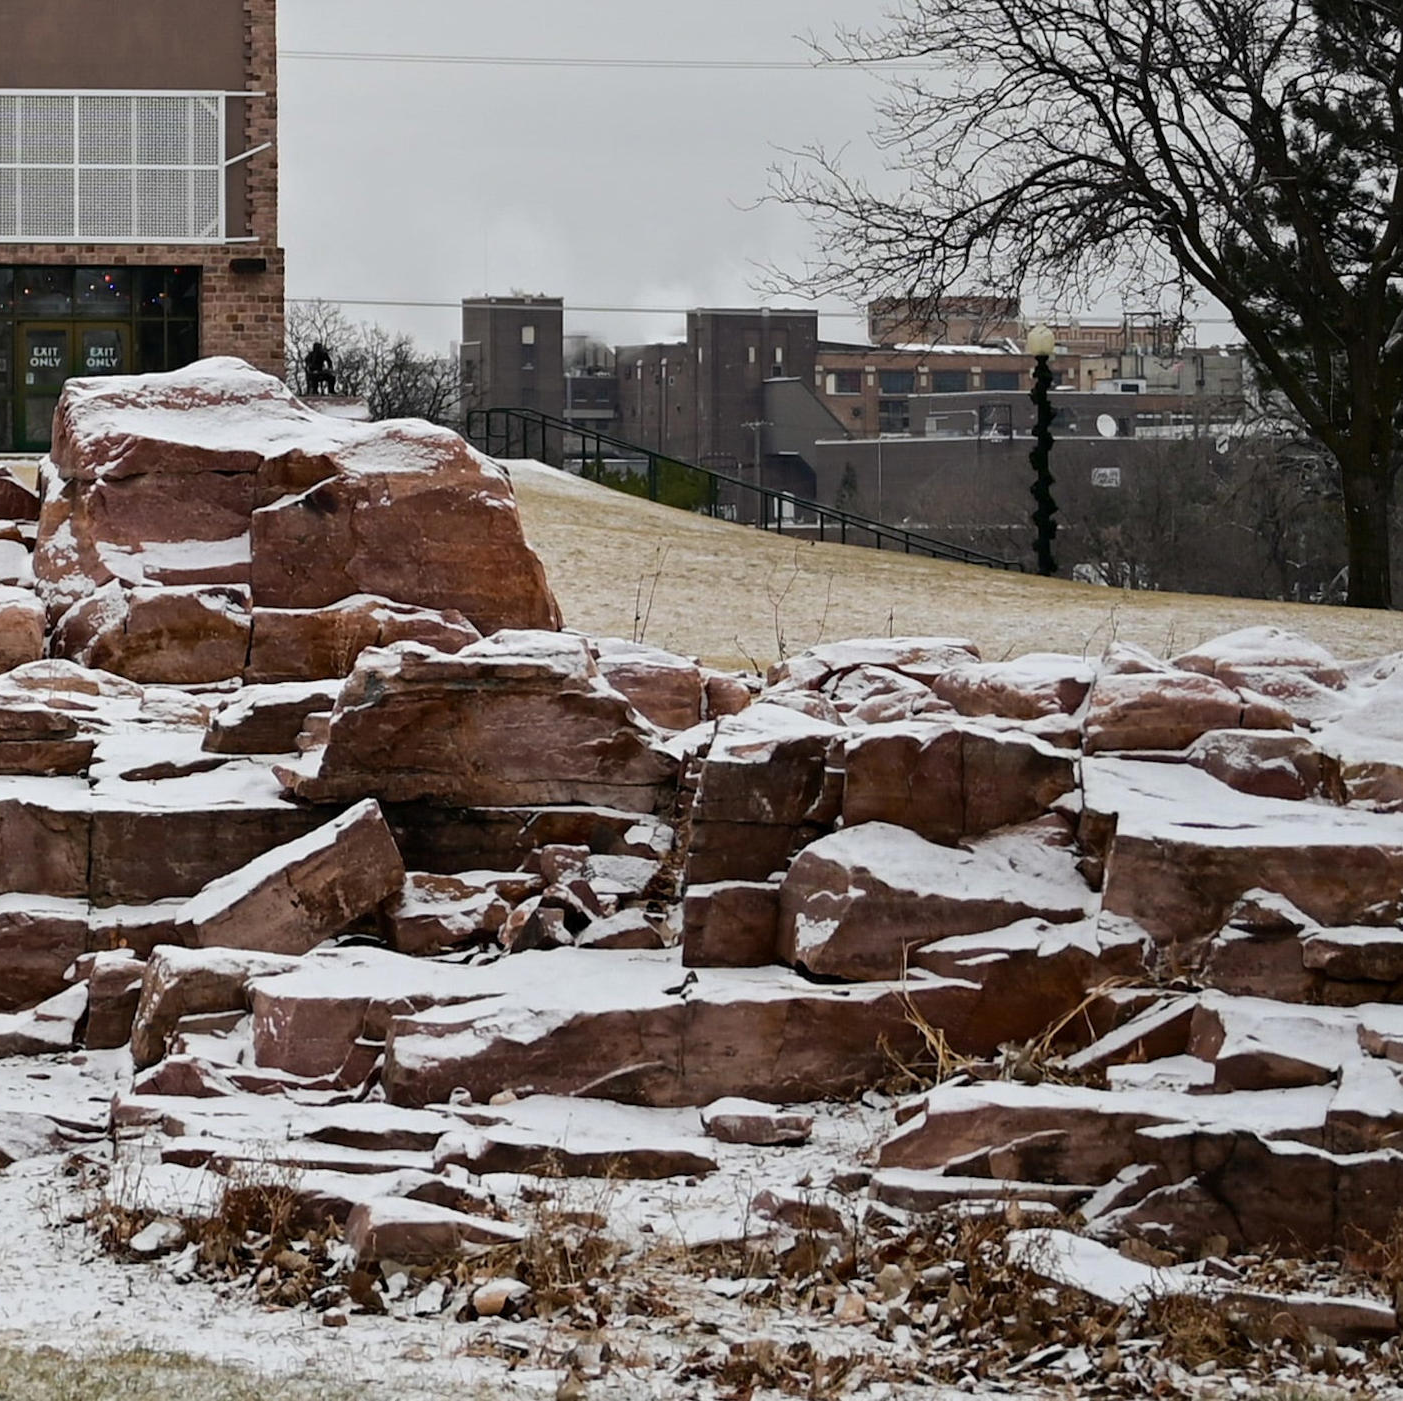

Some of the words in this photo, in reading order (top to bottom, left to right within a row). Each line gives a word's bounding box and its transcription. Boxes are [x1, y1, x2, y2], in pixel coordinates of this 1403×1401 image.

[33, 347, 58, 356] EXIT
[89, 347, 115, 356] EXIT
[30, 358, 62, 367] ONLY
[86, 358, 118, 367] ONLY
